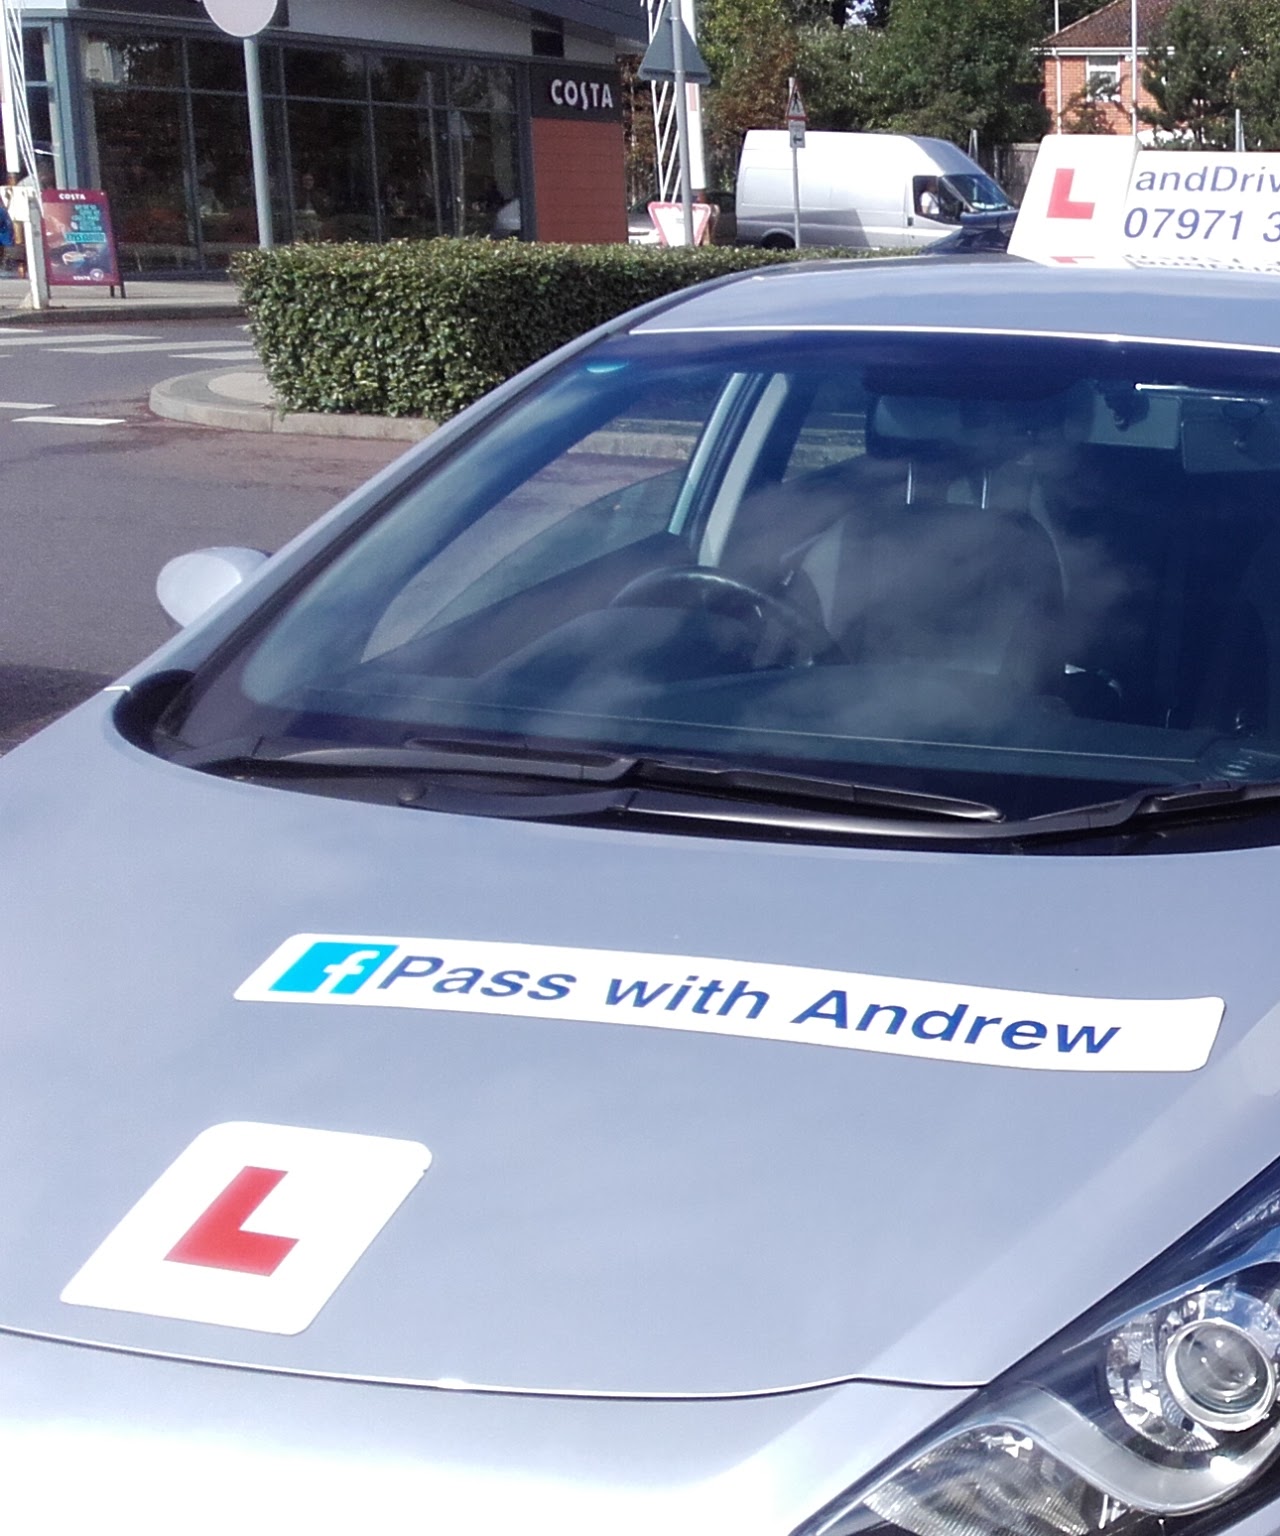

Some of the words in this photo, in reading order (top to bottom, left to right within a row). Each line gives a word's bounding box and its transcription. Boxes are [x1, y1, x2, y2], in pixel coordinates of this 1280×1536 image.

[551, 79, 613, 110] COSTA
[1047, 168, 1094, 219] L
[1124, 207, 1243, 240] 07971
[377, 955, 577, 1001] Pass
[605, 975, 770, 1019] with
[789, 989, 1121, 1054] Andrew
[162, 1165, 300, 1277] L
